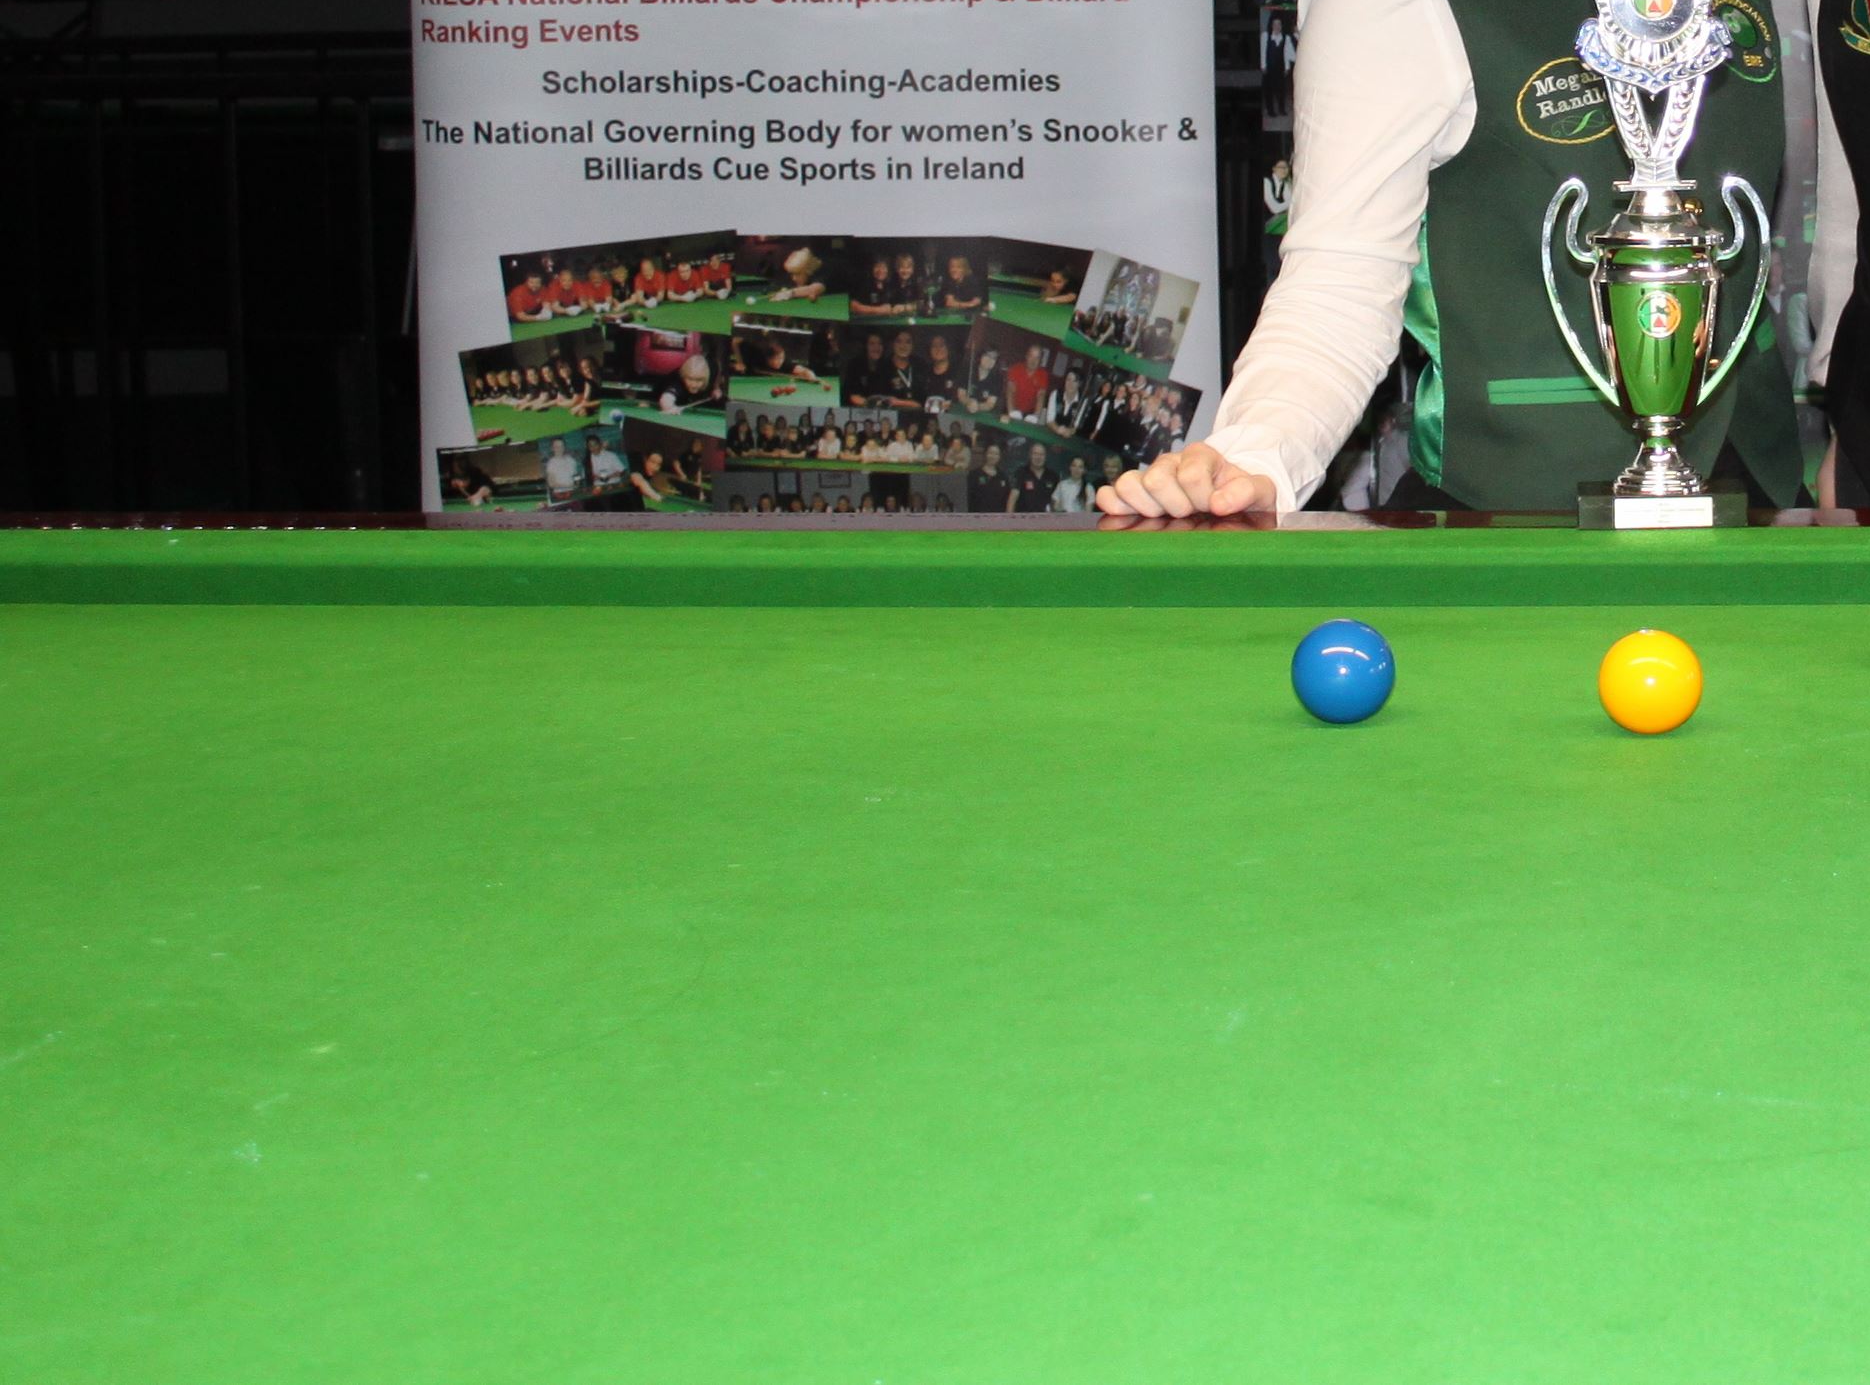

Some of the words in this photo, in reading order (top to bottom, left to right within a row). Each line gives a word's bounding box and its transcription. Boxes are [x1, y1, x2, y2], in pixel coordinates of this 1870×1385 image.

[421, 19, 530, 49] Ranking
[540, 19, 641, 44] Events
[543, 69, 1061, 100] Scholarships-Coaching-Academies
[1536, 87, 1607, 118] Randl
[422, 119, 465, 145] The
[474, 120, 594, 145] National
[604, 120, 756, 150] Governing
[766, 120, 842, 150] Body
[851, 119, 893, 143] for
[1044, 119, 1168, 143] Snooker
[1178, 117, 1199, 142] &
[585, 157, 703, 181] Billiards
[713, 157, 770, 181] Cue
[780, 157, 877, 187] Sports
[888, 157, 913, 180] in
[924, 156, 1024, 180] Ireland
